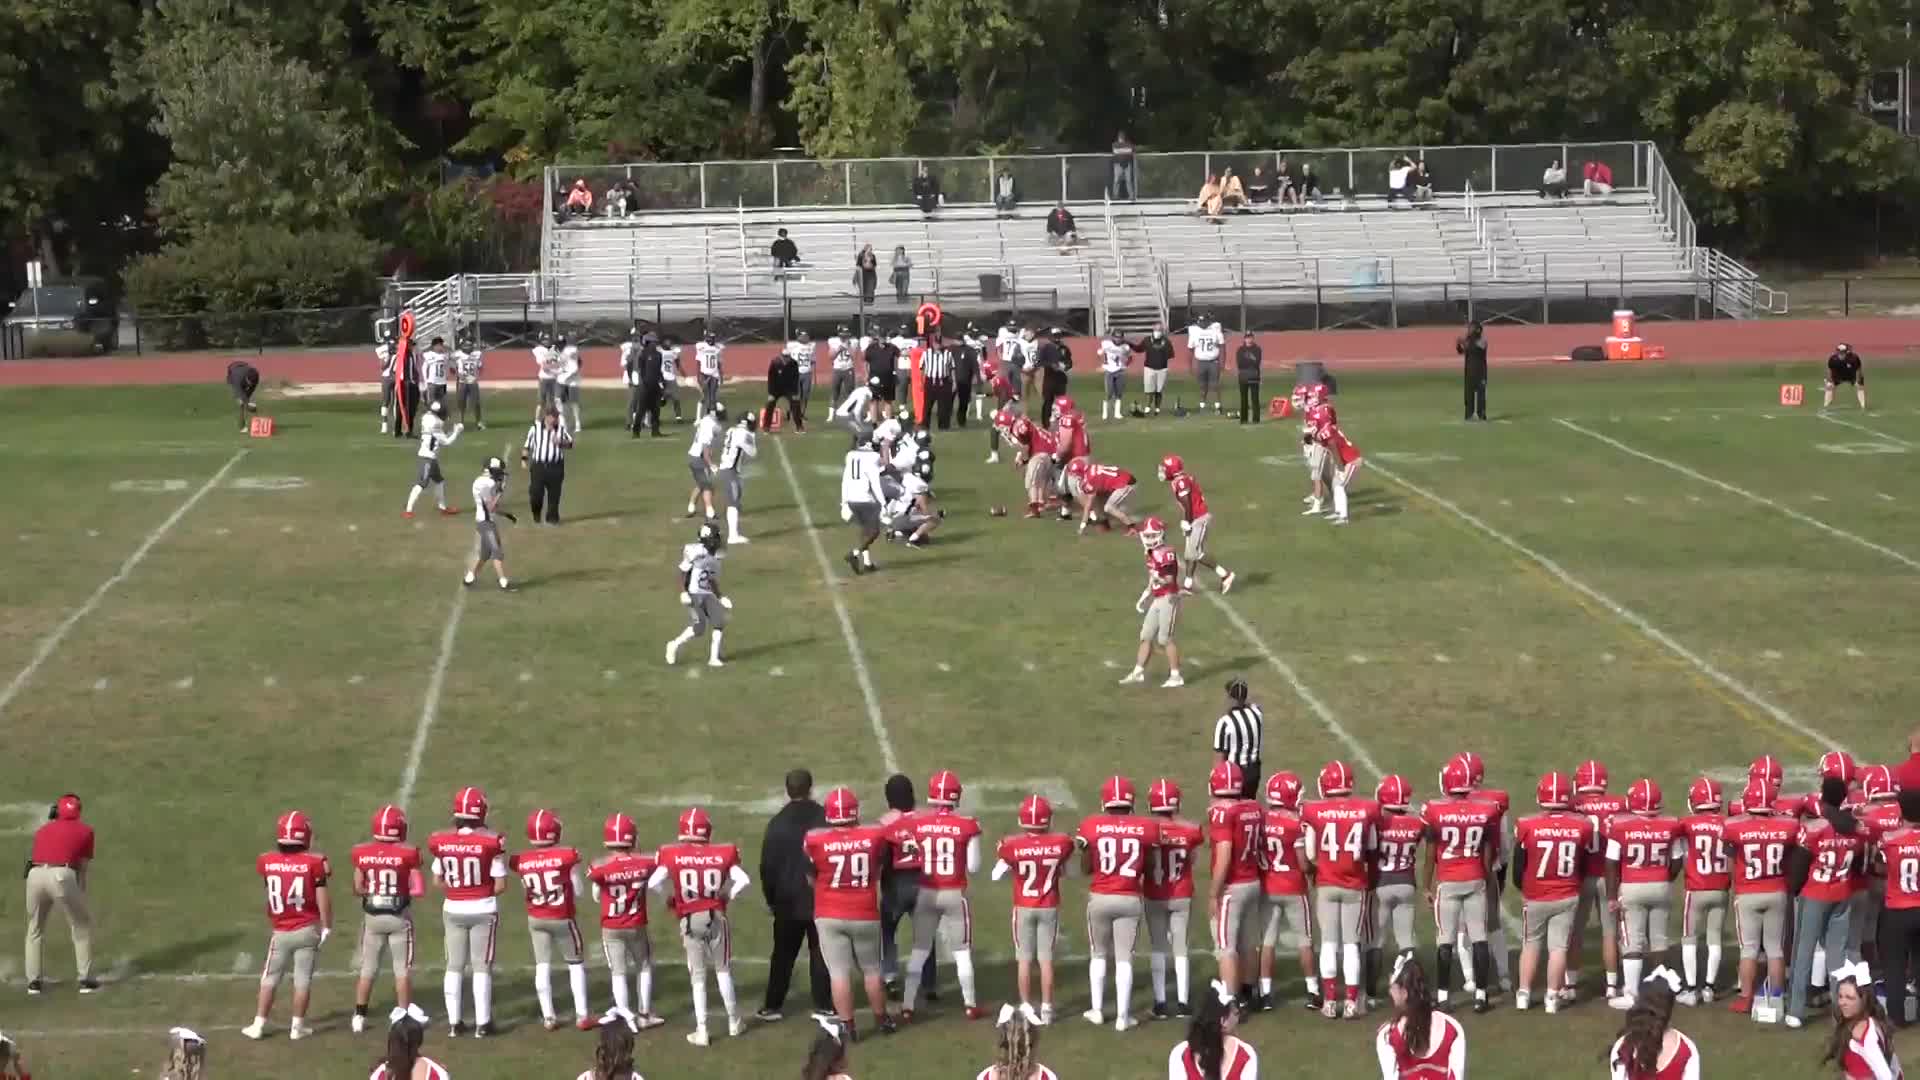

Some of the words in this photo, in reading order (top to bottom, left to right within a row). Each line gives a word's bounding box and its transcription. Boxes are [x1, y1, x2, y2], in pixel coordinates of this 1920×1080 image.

[1317, 810, 1366, 820] HAWKS
[1439, 814, 1488, 824] HAWKS
[917, 824, 961, 836] HAWKS
[1096, 825, 1145, 836] HAWKS
[1533, 828, 1580, 838] HAWKS
[1625, 830, 1671, 840] HAWKS
[1739, 831, 1787, 841] HAWKS
[438, 843, 482, 854] HAWKS
[823, 839, 872, 852] HAWKS
[1320, 822, 1364, 862] 44
[1441, 826, 1484, 860] 28
[921, 836, 955, 876] 18
[1014, 846, 1062, 857] HAWKS
[1097, 837, 1141, 878] 82
[359, 856, 403, 866] HAWKS
[519, 857, 562, 871] HAWKS
[675, 855, 724, 866] HAWKS
[1535, 841, 1577, 878] 78
[1743, 843, 1785, 880] 58
[265, 863, 309, 873] HAWKS
[442, 856, 482, 888] 80
[828, 852, 870, 889] 79
[1018, 859, 1060, 898] 27
[523, 870, 565, 906] 35
[267, 875, 306, 915] 84
